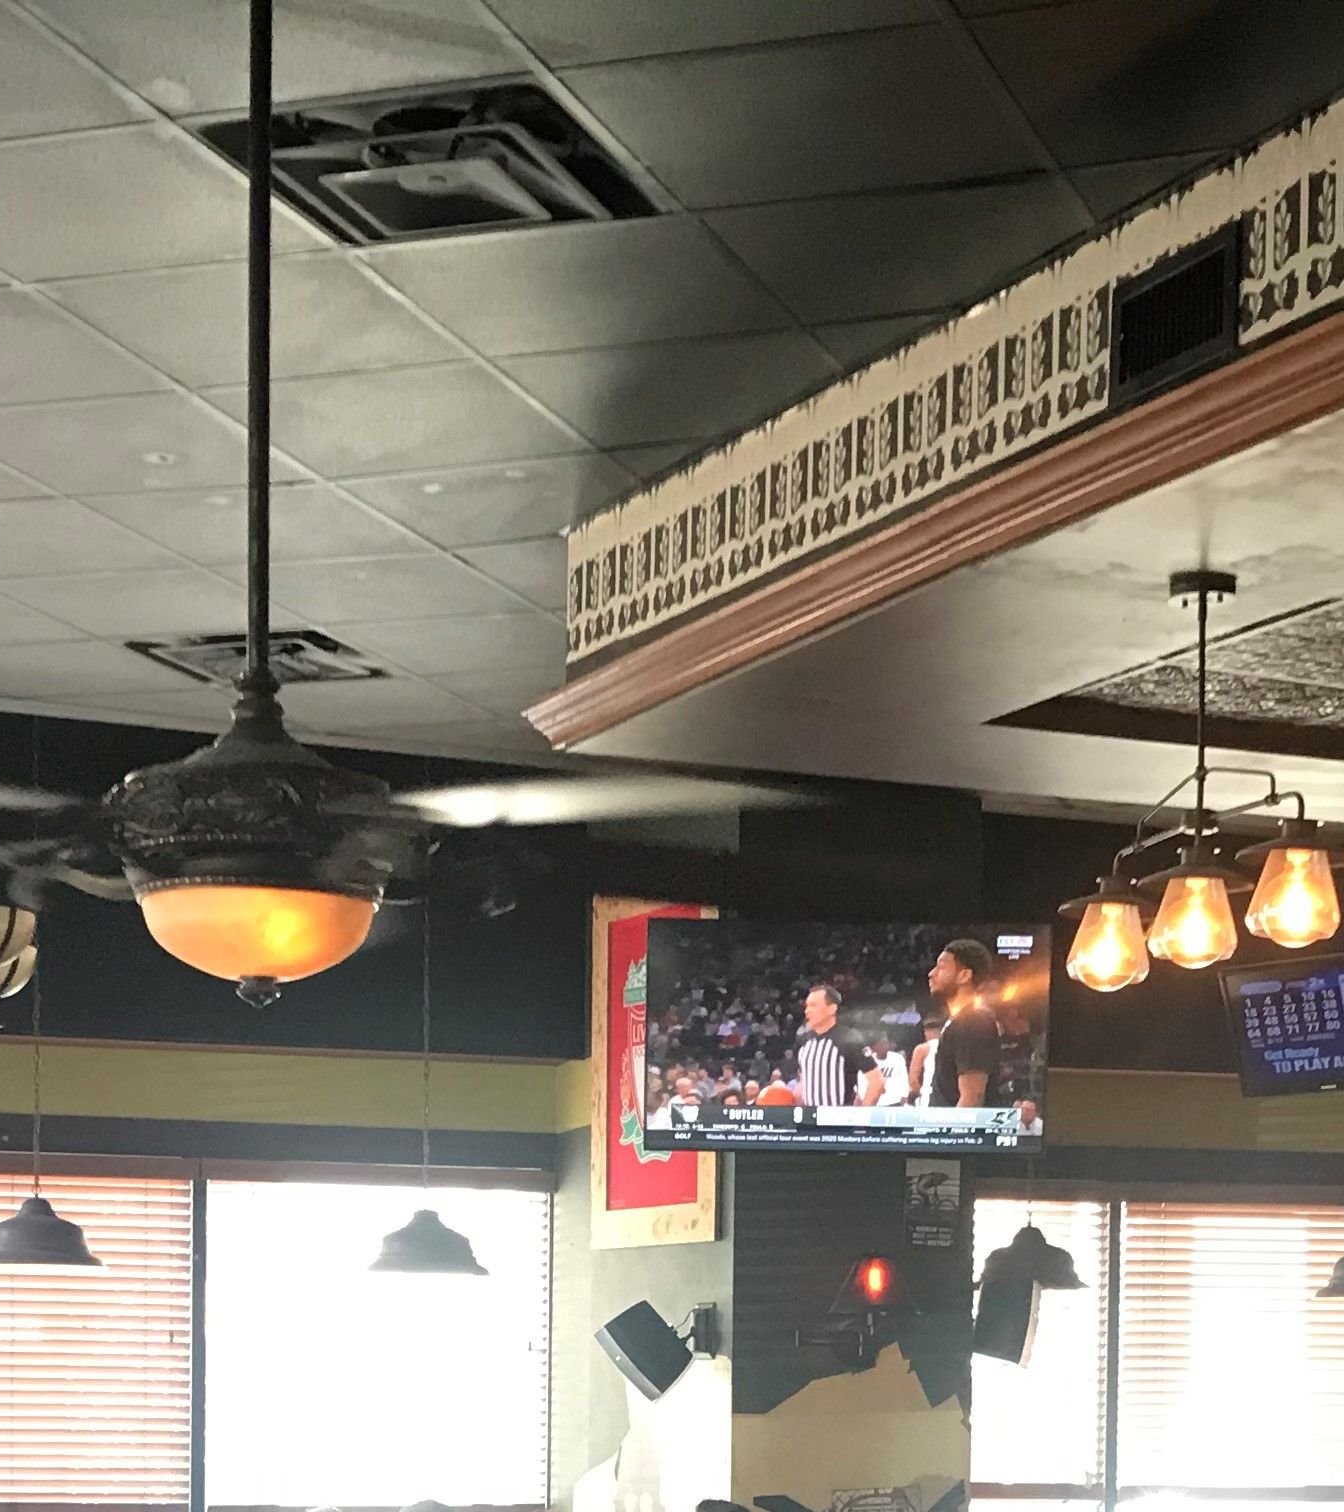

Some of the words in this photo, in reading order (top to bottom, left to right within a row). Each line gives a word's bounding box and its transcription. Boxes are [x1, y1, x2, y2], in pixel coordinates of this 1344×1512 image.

[1286, 1024, 1300, 1035] 71
[1306, 1022, 1320, 1033] 77
[1272, 1060, 1292, 1074] TO
[1294, 1057, 1330, 1072] PLAY
[729, 1109, 764, 1121] BUTLER
[996, 1136, 1018, 1147] FS1
